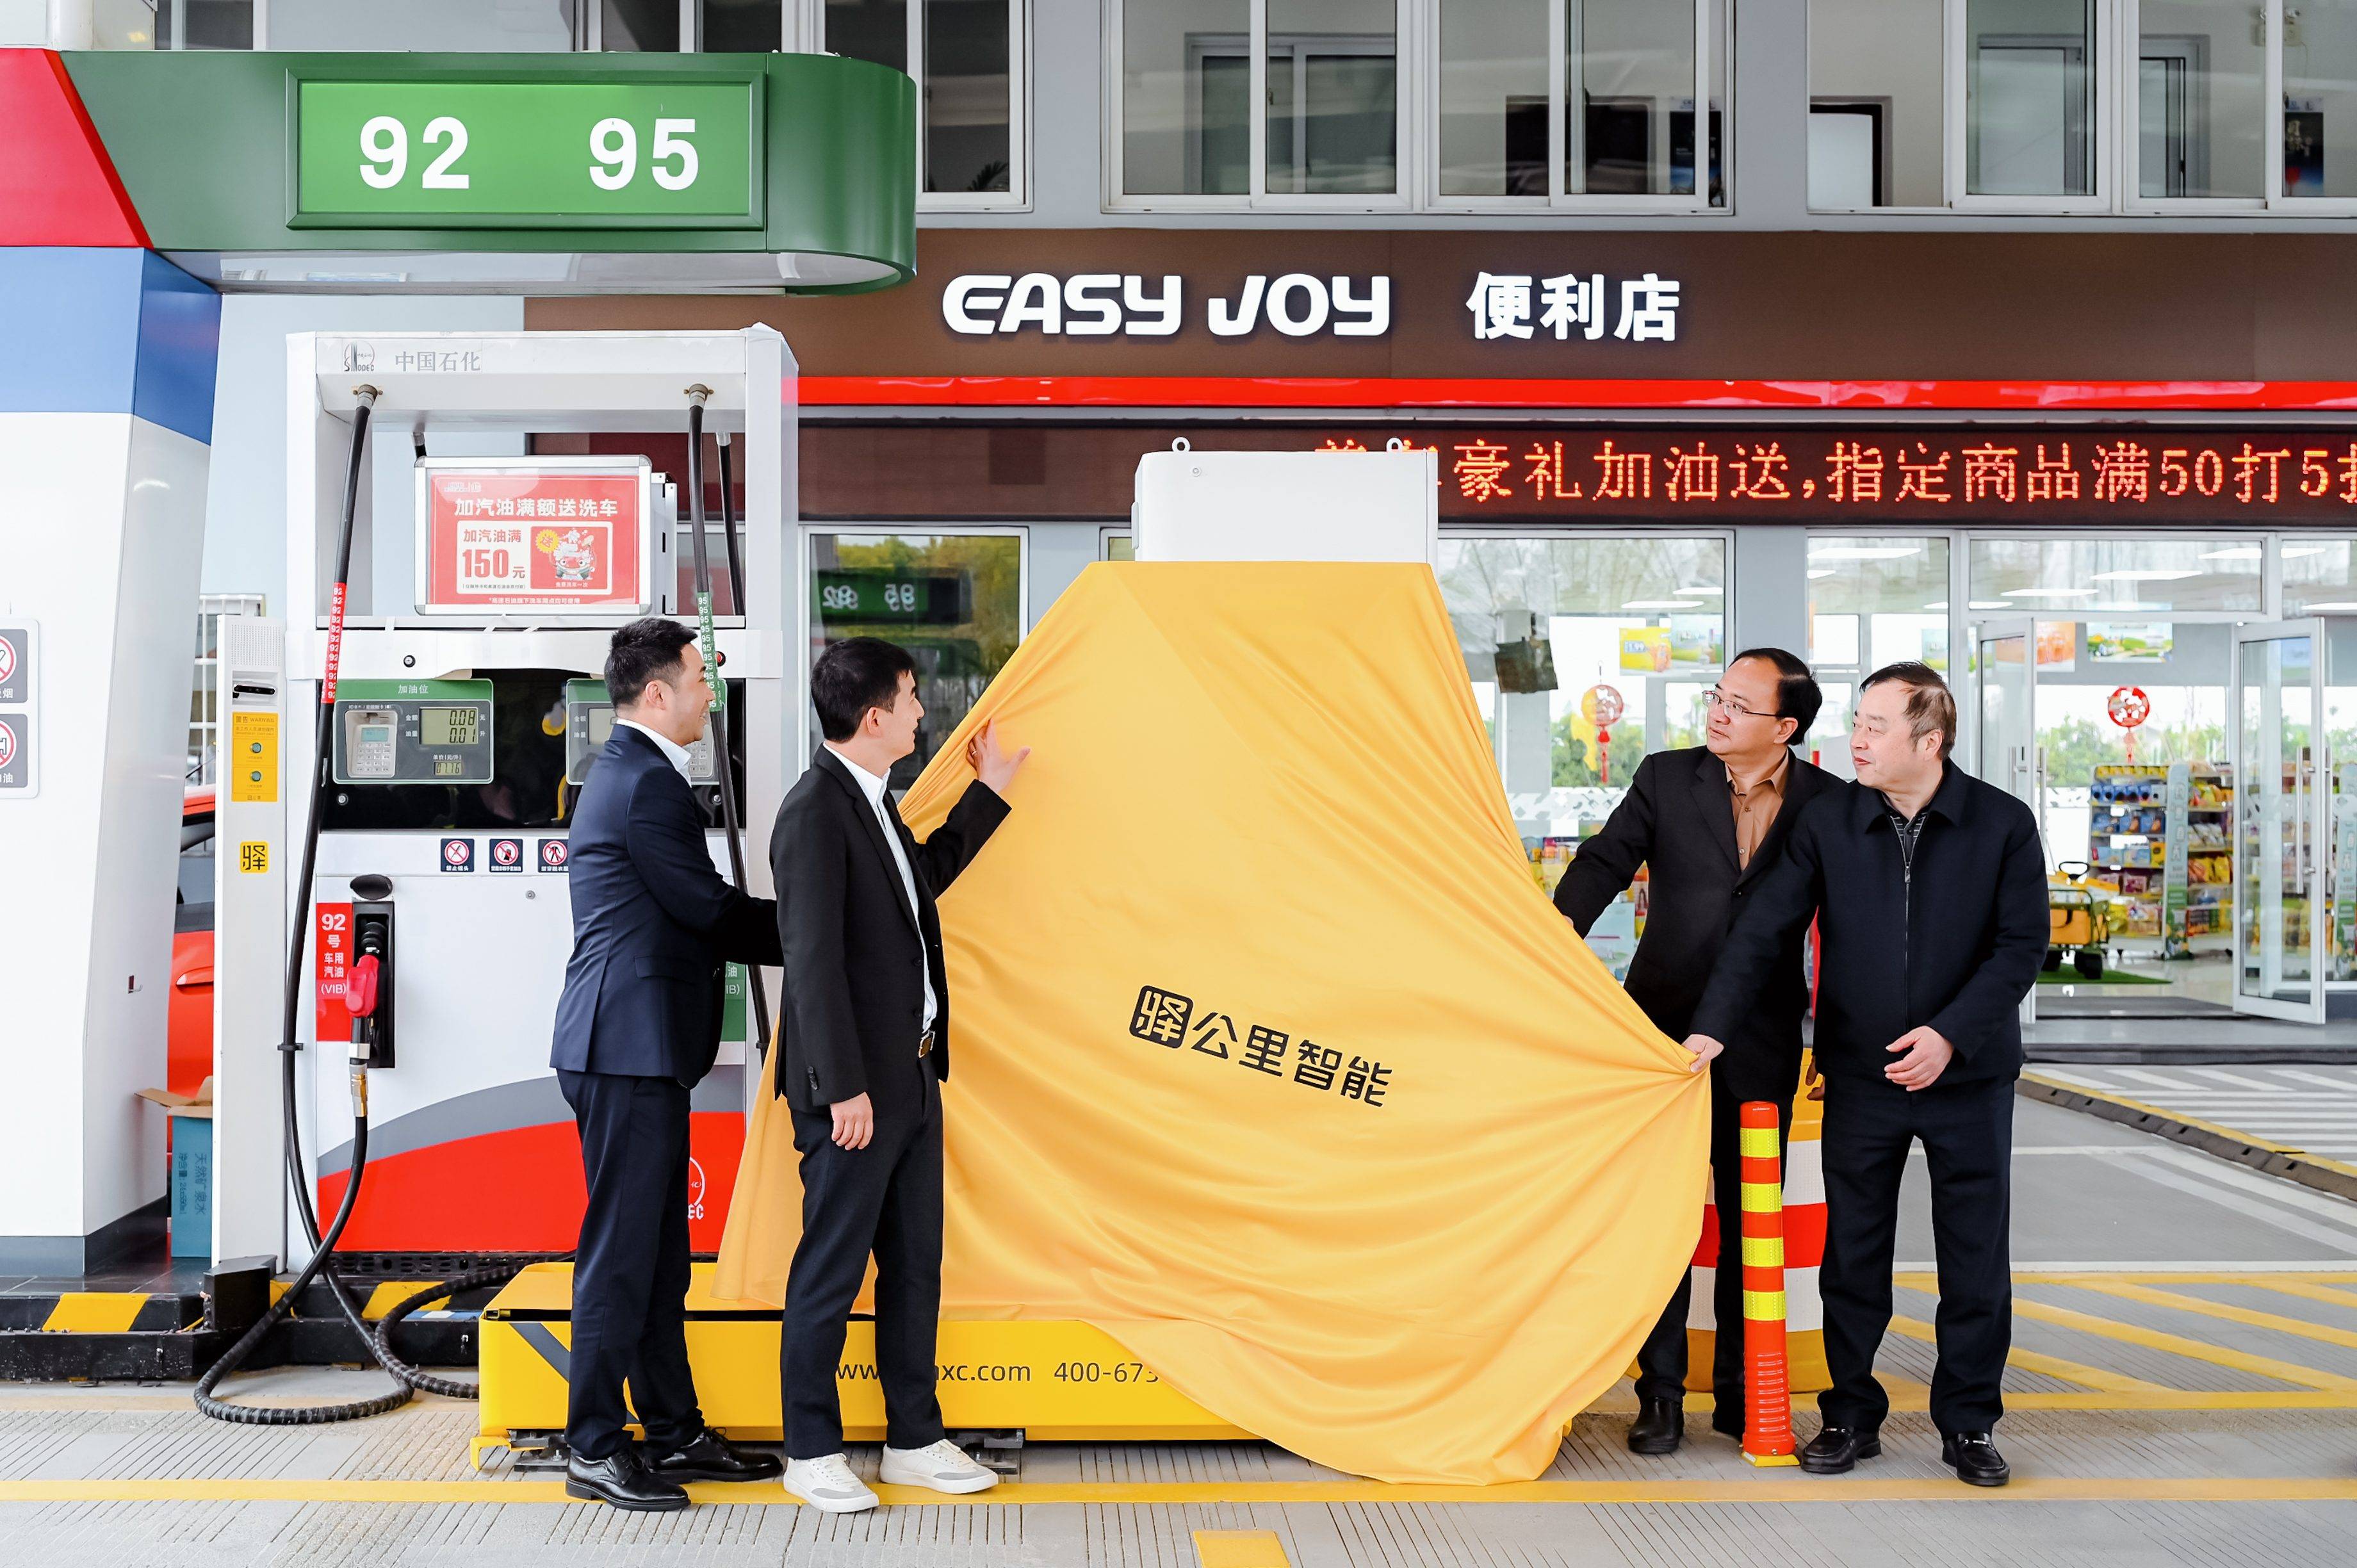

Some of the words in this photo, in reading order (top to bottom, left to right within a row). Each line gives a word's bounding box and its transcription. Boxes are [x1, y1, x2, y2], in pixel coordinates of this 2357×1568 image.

[359, 116, 469, 190] 92
[589, 117, 699, 191] 95
[942, 273, 1182, 335] EASY
[1208, 273, 1390, 336] JOY
[1465, 272, 1680, 341] 便利店
[395, 351, 480, 372] 中国石化
[1315, 438, 2357, 503] 豪礼加油送,指定商品满50打5
[453, 498, 618, 517] 加汽油满额送洗车
[463, 529, 521, 543] 加汽油满
[398, 685, 428, 694] 加油位
[449, 710, 475, 726] 0.08
[449, 728, 475, 744] 0.01
[0, 772, 13, 783] 油
[322, 913, 346, 931] 92
[327, 934, 341, 948] 号
[324, 952, 344, 964] 车用
[324, 966, 344, 978] 汽油
[321, 983, 347, 994] (VIB)
[726, 984, 740, 995] IB)
[195, 1152, 207, 1214] 天然矿泉水
